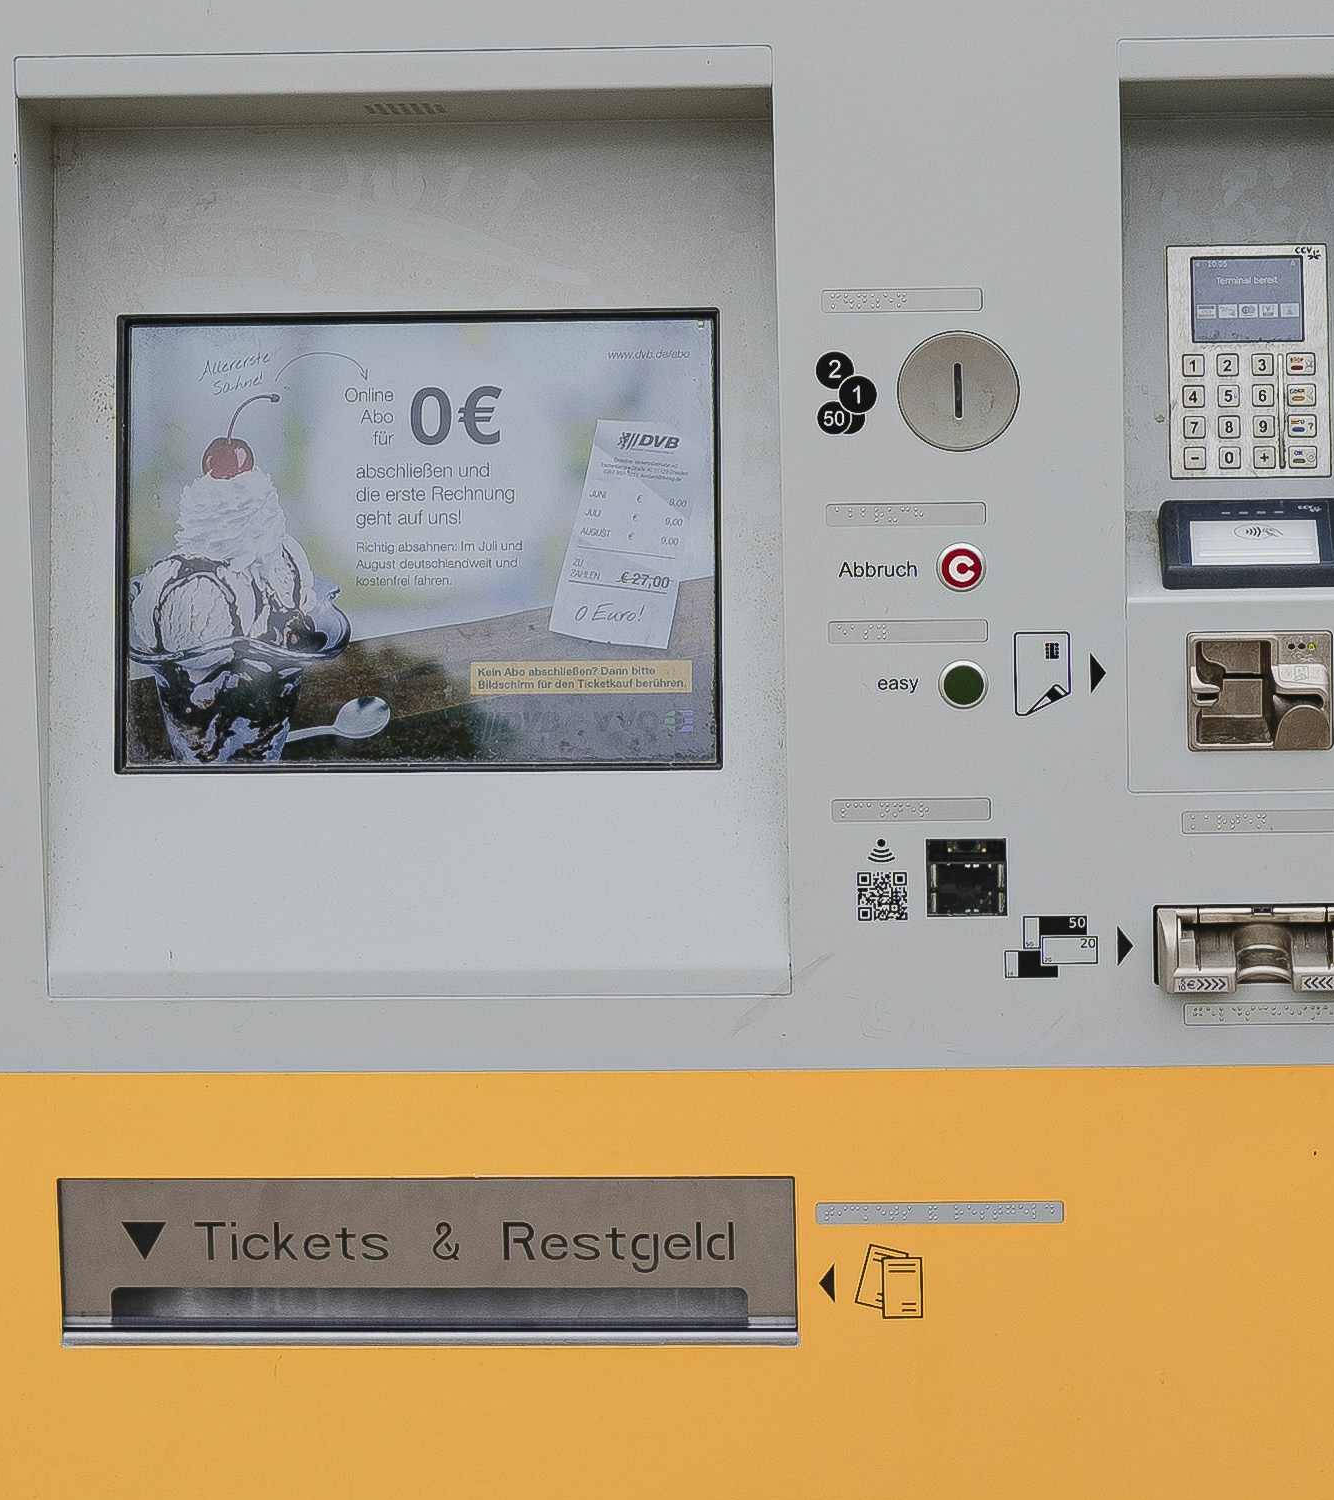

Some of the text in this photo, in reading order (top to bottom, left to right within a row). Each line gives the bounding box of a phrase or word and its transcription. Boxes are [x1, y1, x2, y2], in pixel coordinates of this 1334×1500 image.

[1215, 275, 1279, 286] Terminal bereit
[607, 348, 691, 359] www.dvb.de/abo
[828, 359, 842, 379] 2
[1189, 358, 1267, 372] 1 2 3
[344, 387, 394, 403] Online
[852, 384, 861, 405] 1
[1188, 389, 1267, 404] 4 5 6
[360, 409, 394, 424] Abo
[823, 410, 845, 427] 50
[1189, 420, 1268, 435] 7 8 9
[372, 430, 395, 446] für
[638, 433, 680, 449] DVB
[1224, 451, 1234, 464] 0
[355, 462, 490, 479] abschließen und
[355, 485, 515, 504] die erste Rechnung
[355, 509, 463, 529] geht auf uns!
[580, 527, 611, 538] AUGUST
[355, 540, 523, 555] Richtig absahnen: Im Juli und
[355, 557, 518, 572] August deutschlandweit und
[838, 561, 918, 578] Abbruch
[948, 555, 976, 583] C
[355, 574, 453, 587] kostenfrei fahren.
[591, 602, 646, 622] Euro!
[477, 665, 656, 677] Kein Abo abschließen? Dann bitte
[477, 678, 687, 690] Bildschirm für den Ticketkauf berühren.
[877, 677, 919, 694] easy
[1068, 916, 1087, 929] 50
[1080, 938, 1096, 949] 20
[193, 1220, 736, 1274] Tickets & Restgeld
